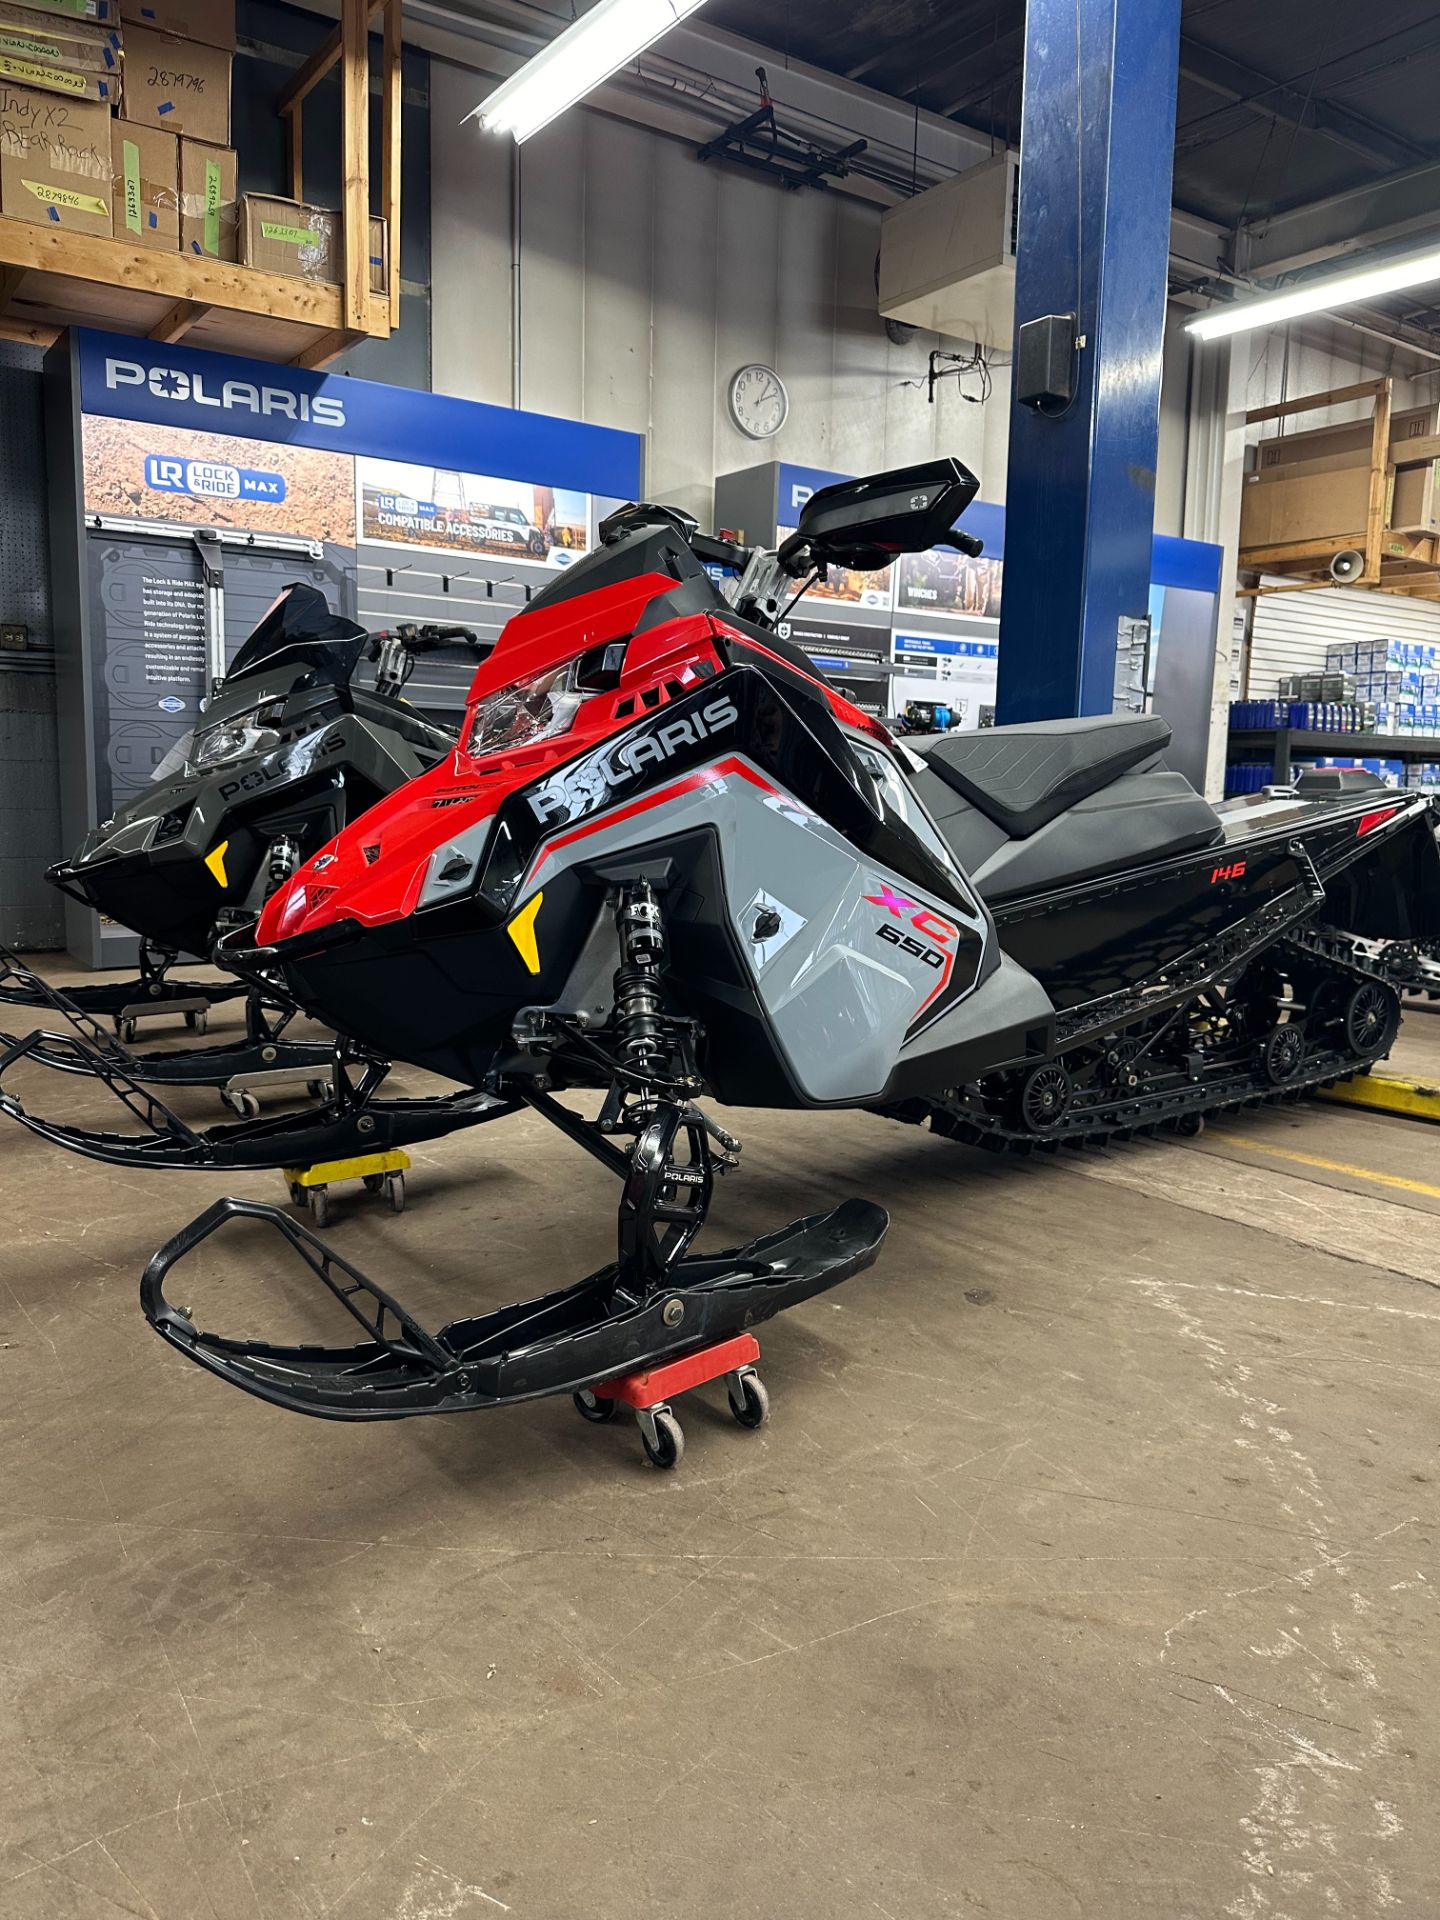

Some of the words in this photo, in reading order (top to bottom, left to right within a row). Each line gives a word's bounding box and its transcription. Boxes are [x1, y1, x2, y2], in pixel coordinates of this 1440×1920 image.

[147, 66, 205, 93] 2879796
[36, 186, 80, 206] 2879846
[105, 358, 346, 428] POLARIS
[193, 466, 234, 481] LOCK
[244, 479, 278, 494] MAX
[791, 484, 817, 508] P
[378, 512, 445, 533] COMPATIBLE
[446, 521, 514, 543] ACCESSORIES
[142, 576, 152, 584] The
[907, 586, 937, 600] WINCHES
[156, 622, 184, 630] technology
[526, 695, 738, 824] POLARIS
[1210, 861, 1246, 884] 146
[862, 883, 958, 945] XC
[875, 923, 945, 970] 650
[664, 1171, 704, 1184] POLARIS
